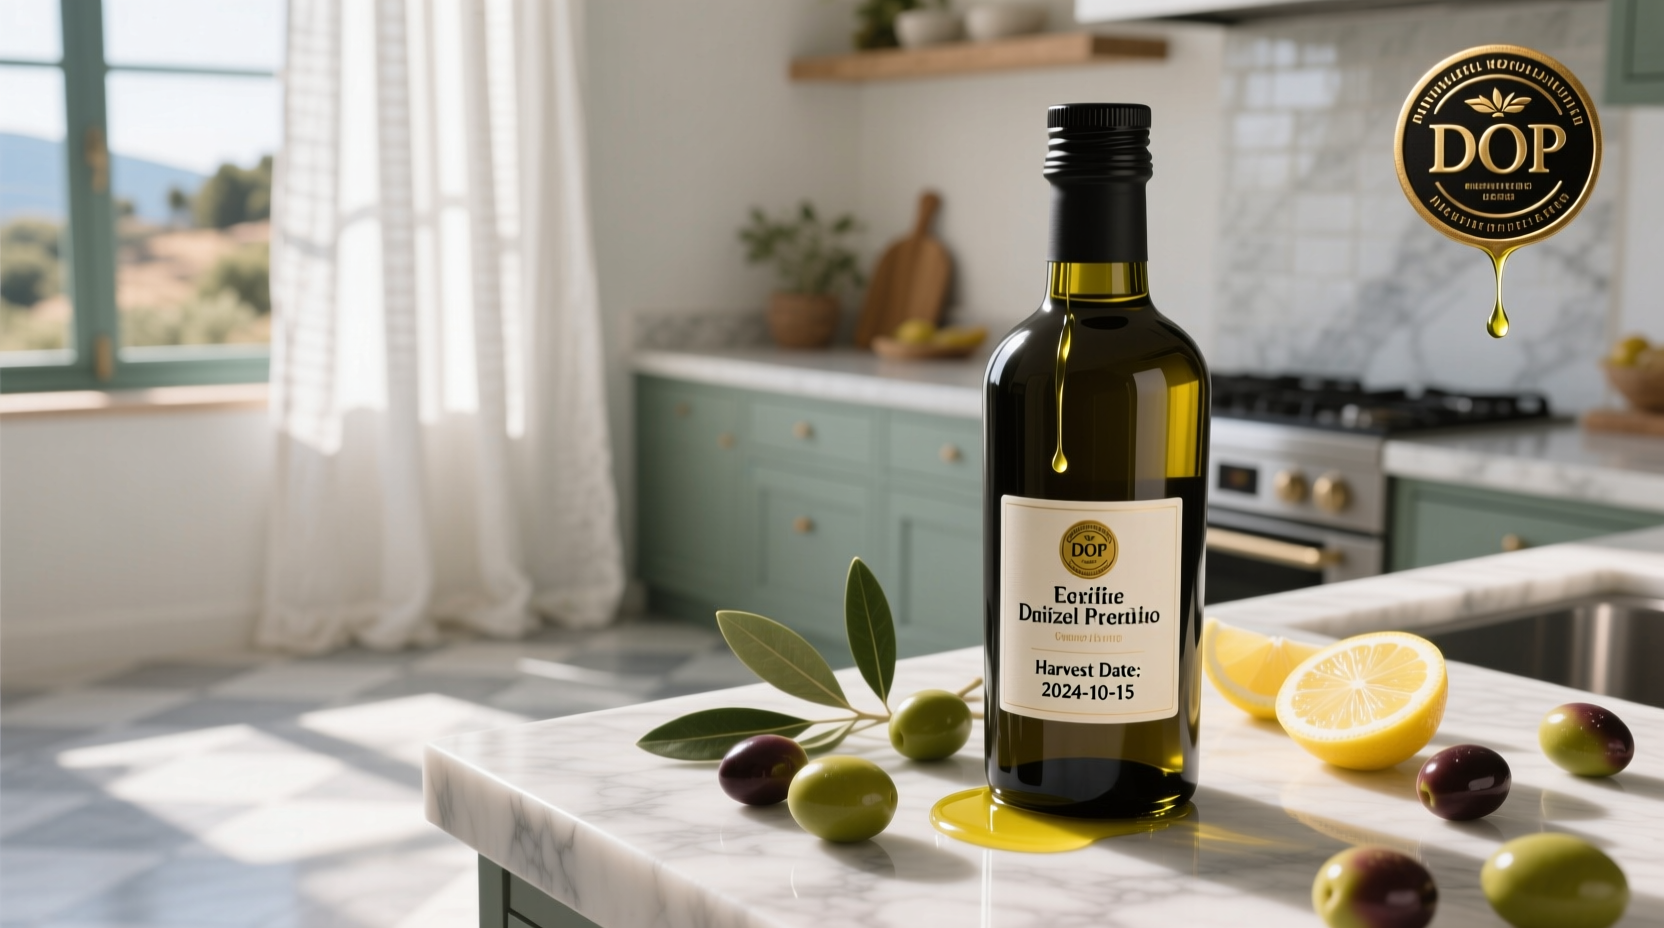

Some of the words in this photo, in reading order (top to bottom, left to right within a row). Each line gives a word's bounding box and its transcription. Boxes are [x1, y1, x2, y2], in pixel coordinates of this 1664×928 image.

[1072, 542, 1107, 558] DOP
[1035, 660, 1094, 677] Harvest
[1099, 663, 1141, 677] Date:
[1041, 682, 1135, 700] 2024-10-15
